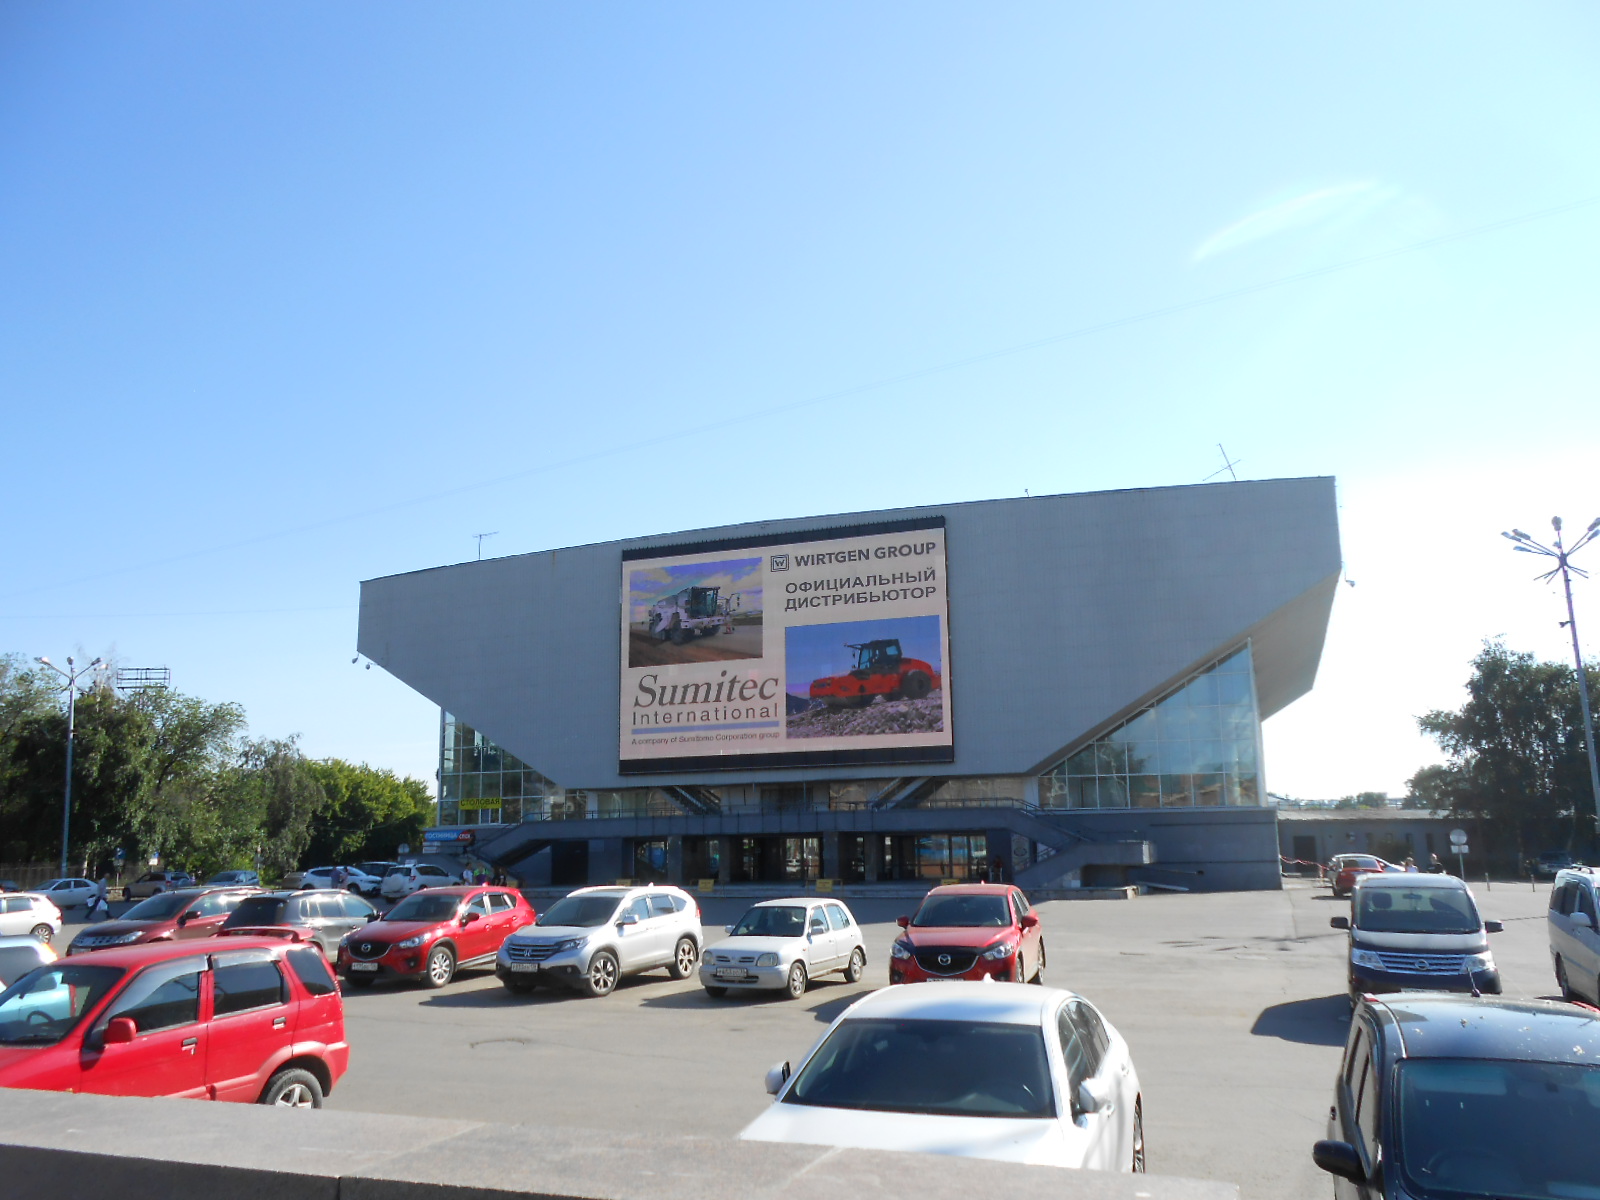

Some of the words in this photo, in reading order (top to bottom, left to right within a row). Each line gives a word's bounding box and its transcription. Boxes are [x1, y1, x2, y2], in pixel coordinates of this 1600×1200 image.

[795, 548, 870, 567] WIRTGEN
[874, 542, 936, 560] GROUP
[785, 566, 936, 594] ОФИЦИАЛЬНЫЙ
[784, 586, 937, 612] ДИСТРИБЬЮТОР
[633, 670, 779, 708] Sumitec
[632, 702, 778, 726] International
[638, 737, 669, 746] company
[715, 732, 757, 742] Corporation
[758, 731, 780, 741] group
[460, 798, 500, 806] СТОЛОВАЯ
